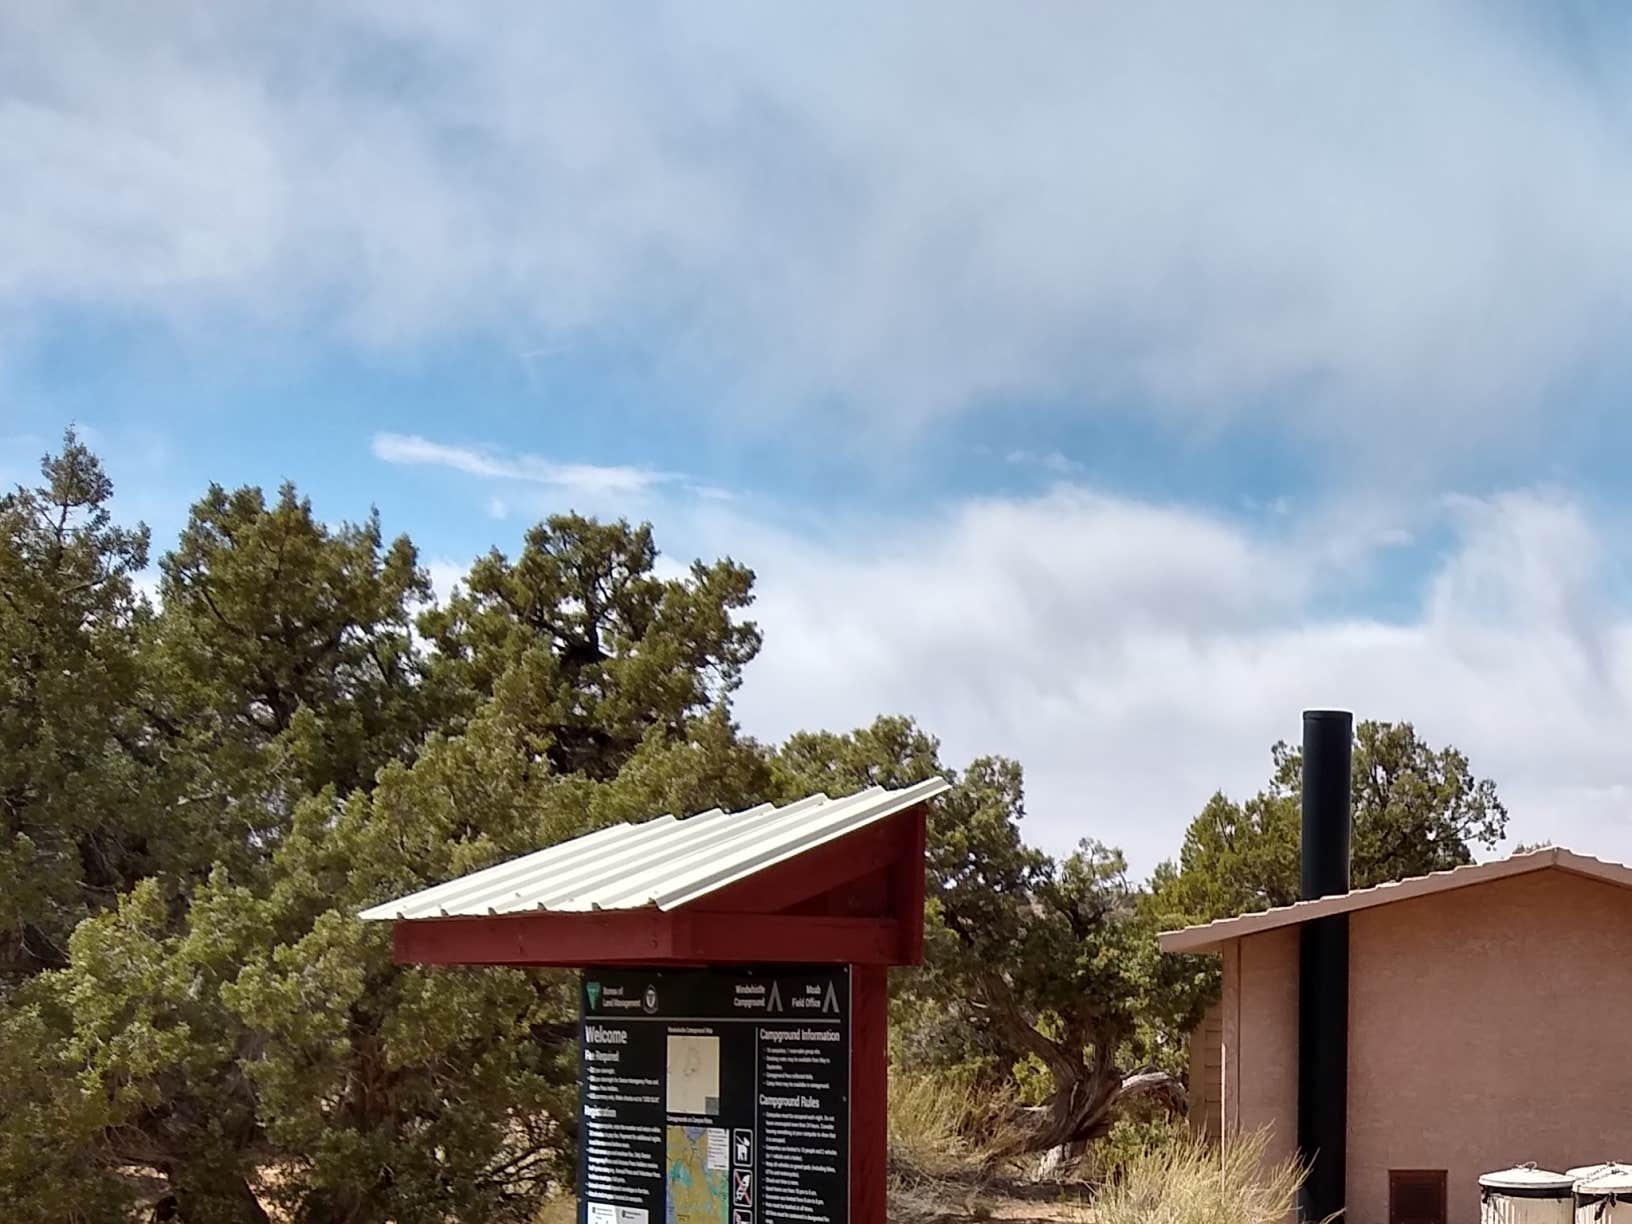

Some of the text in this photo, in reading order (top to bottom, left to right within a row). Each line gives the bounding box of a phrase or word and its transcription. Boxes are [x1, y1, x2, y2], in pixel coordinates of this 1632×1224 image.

[733, 997, 765, 1008] Campground
[791, 997, 821, 1008] Field Office
[584, 1025, 628, 1044] Welcome
[760, 1028, 840, 1043] Campground Information
[759, 1094, 820, 1109] Campground Rules
